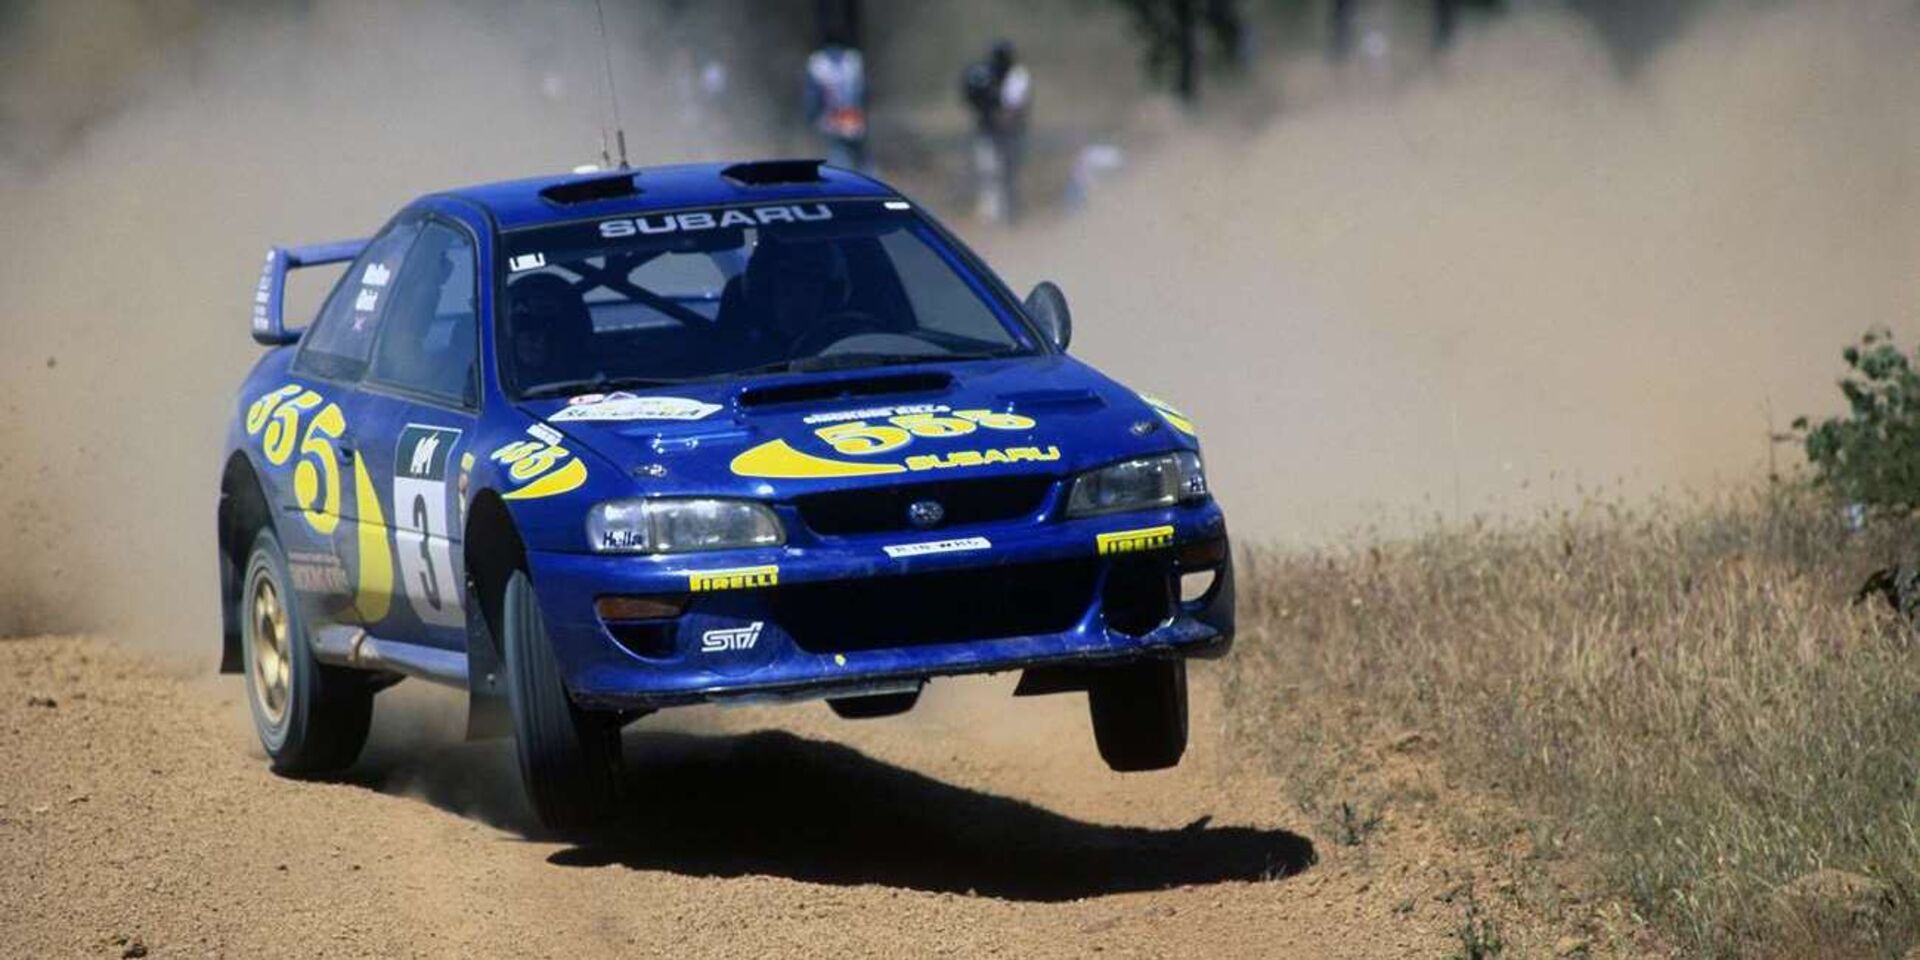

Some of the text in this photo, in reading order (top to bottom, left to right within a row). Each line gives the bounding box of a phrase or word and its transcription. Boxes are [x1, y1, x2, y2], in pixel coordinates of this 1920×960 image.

[599, 204, 832, 238] SUBARU
[814, 410, 1036, 455] 555
[247, 384, 346, 533] 555
[905, 446, 1061, 471] SUBARU
[412, 493, 442, 611] 3
[690, 565, 778, 592] PIRELLI
